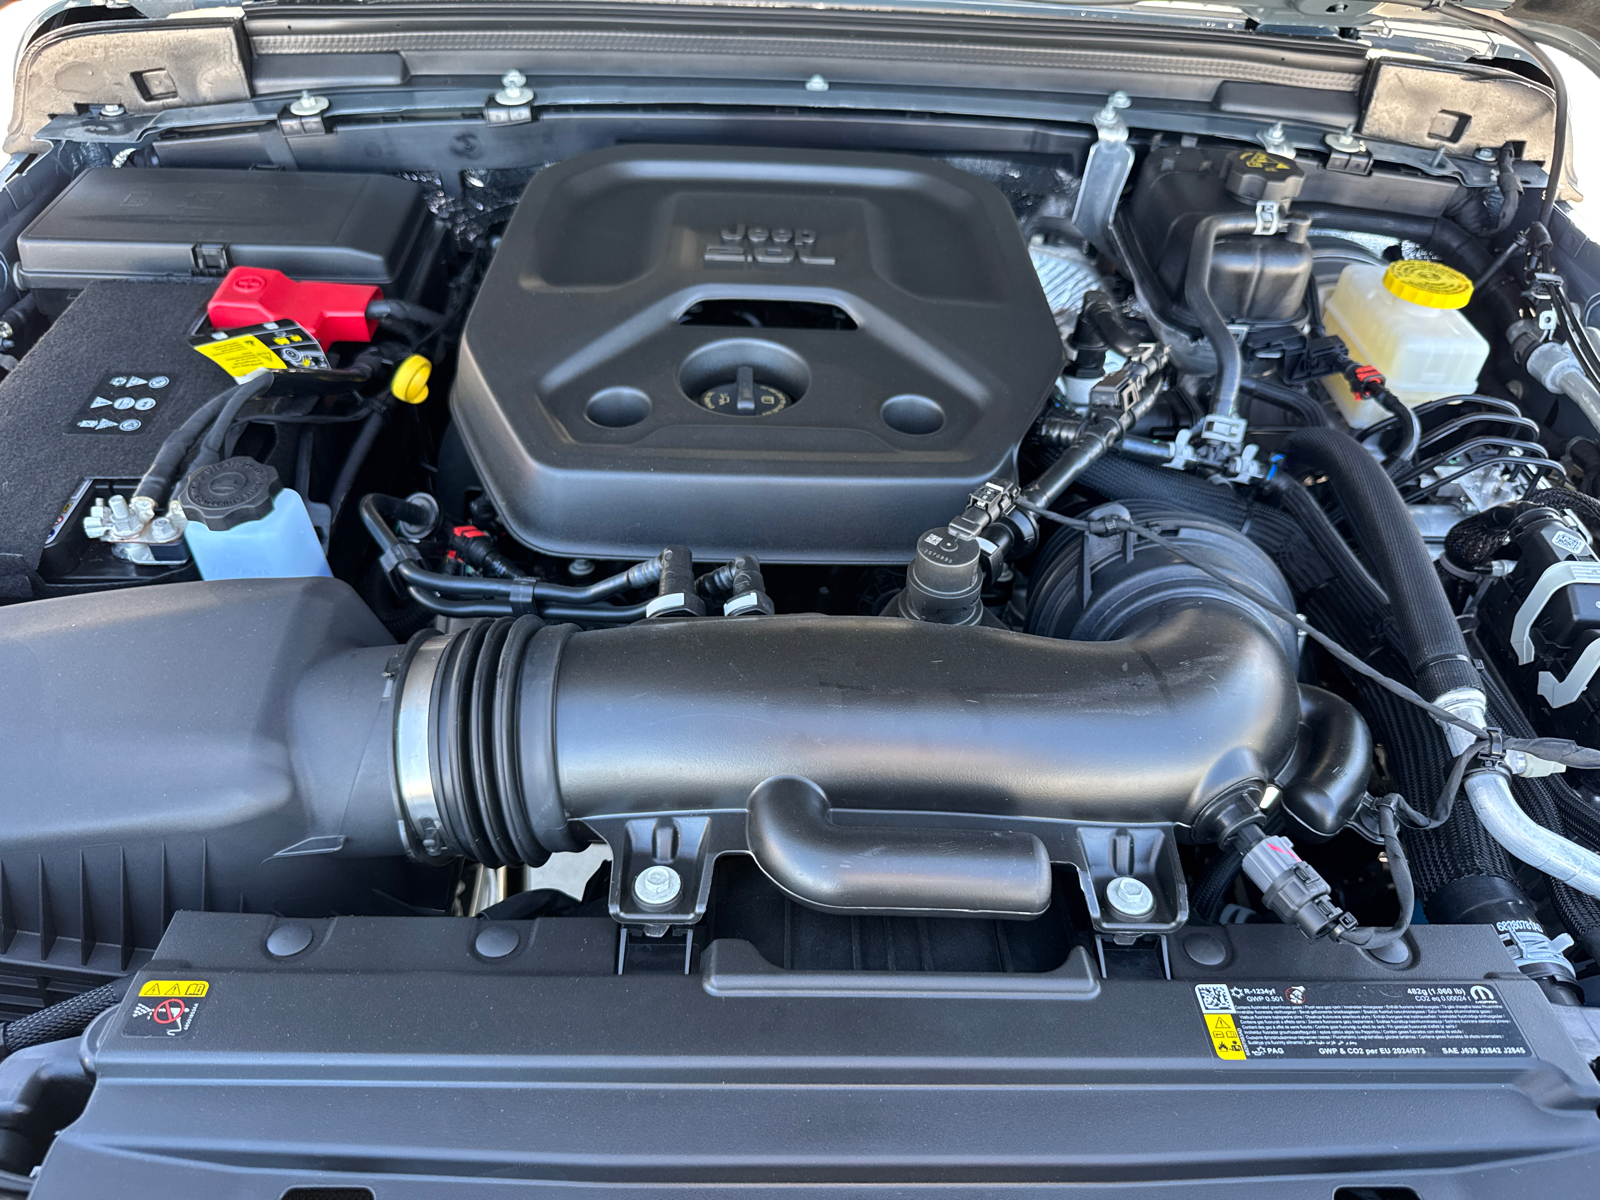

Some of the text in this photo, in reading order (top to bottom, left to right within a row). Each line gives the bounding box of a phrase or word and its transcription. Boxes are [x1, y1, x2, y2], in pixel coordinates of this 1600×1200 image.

[721, 223, 817, 246] Jeep
[1318, 1047, 1338, 1055] GWP
[1347, 1047, 1364, 1055] CO2
[1365, 1048, 1378, 1056] per
[1379, 1047, 1391, 1055] EU
[1441, 1047, 1459, 1055] SAE
[1460, 1047, 1479, 1055] J639
